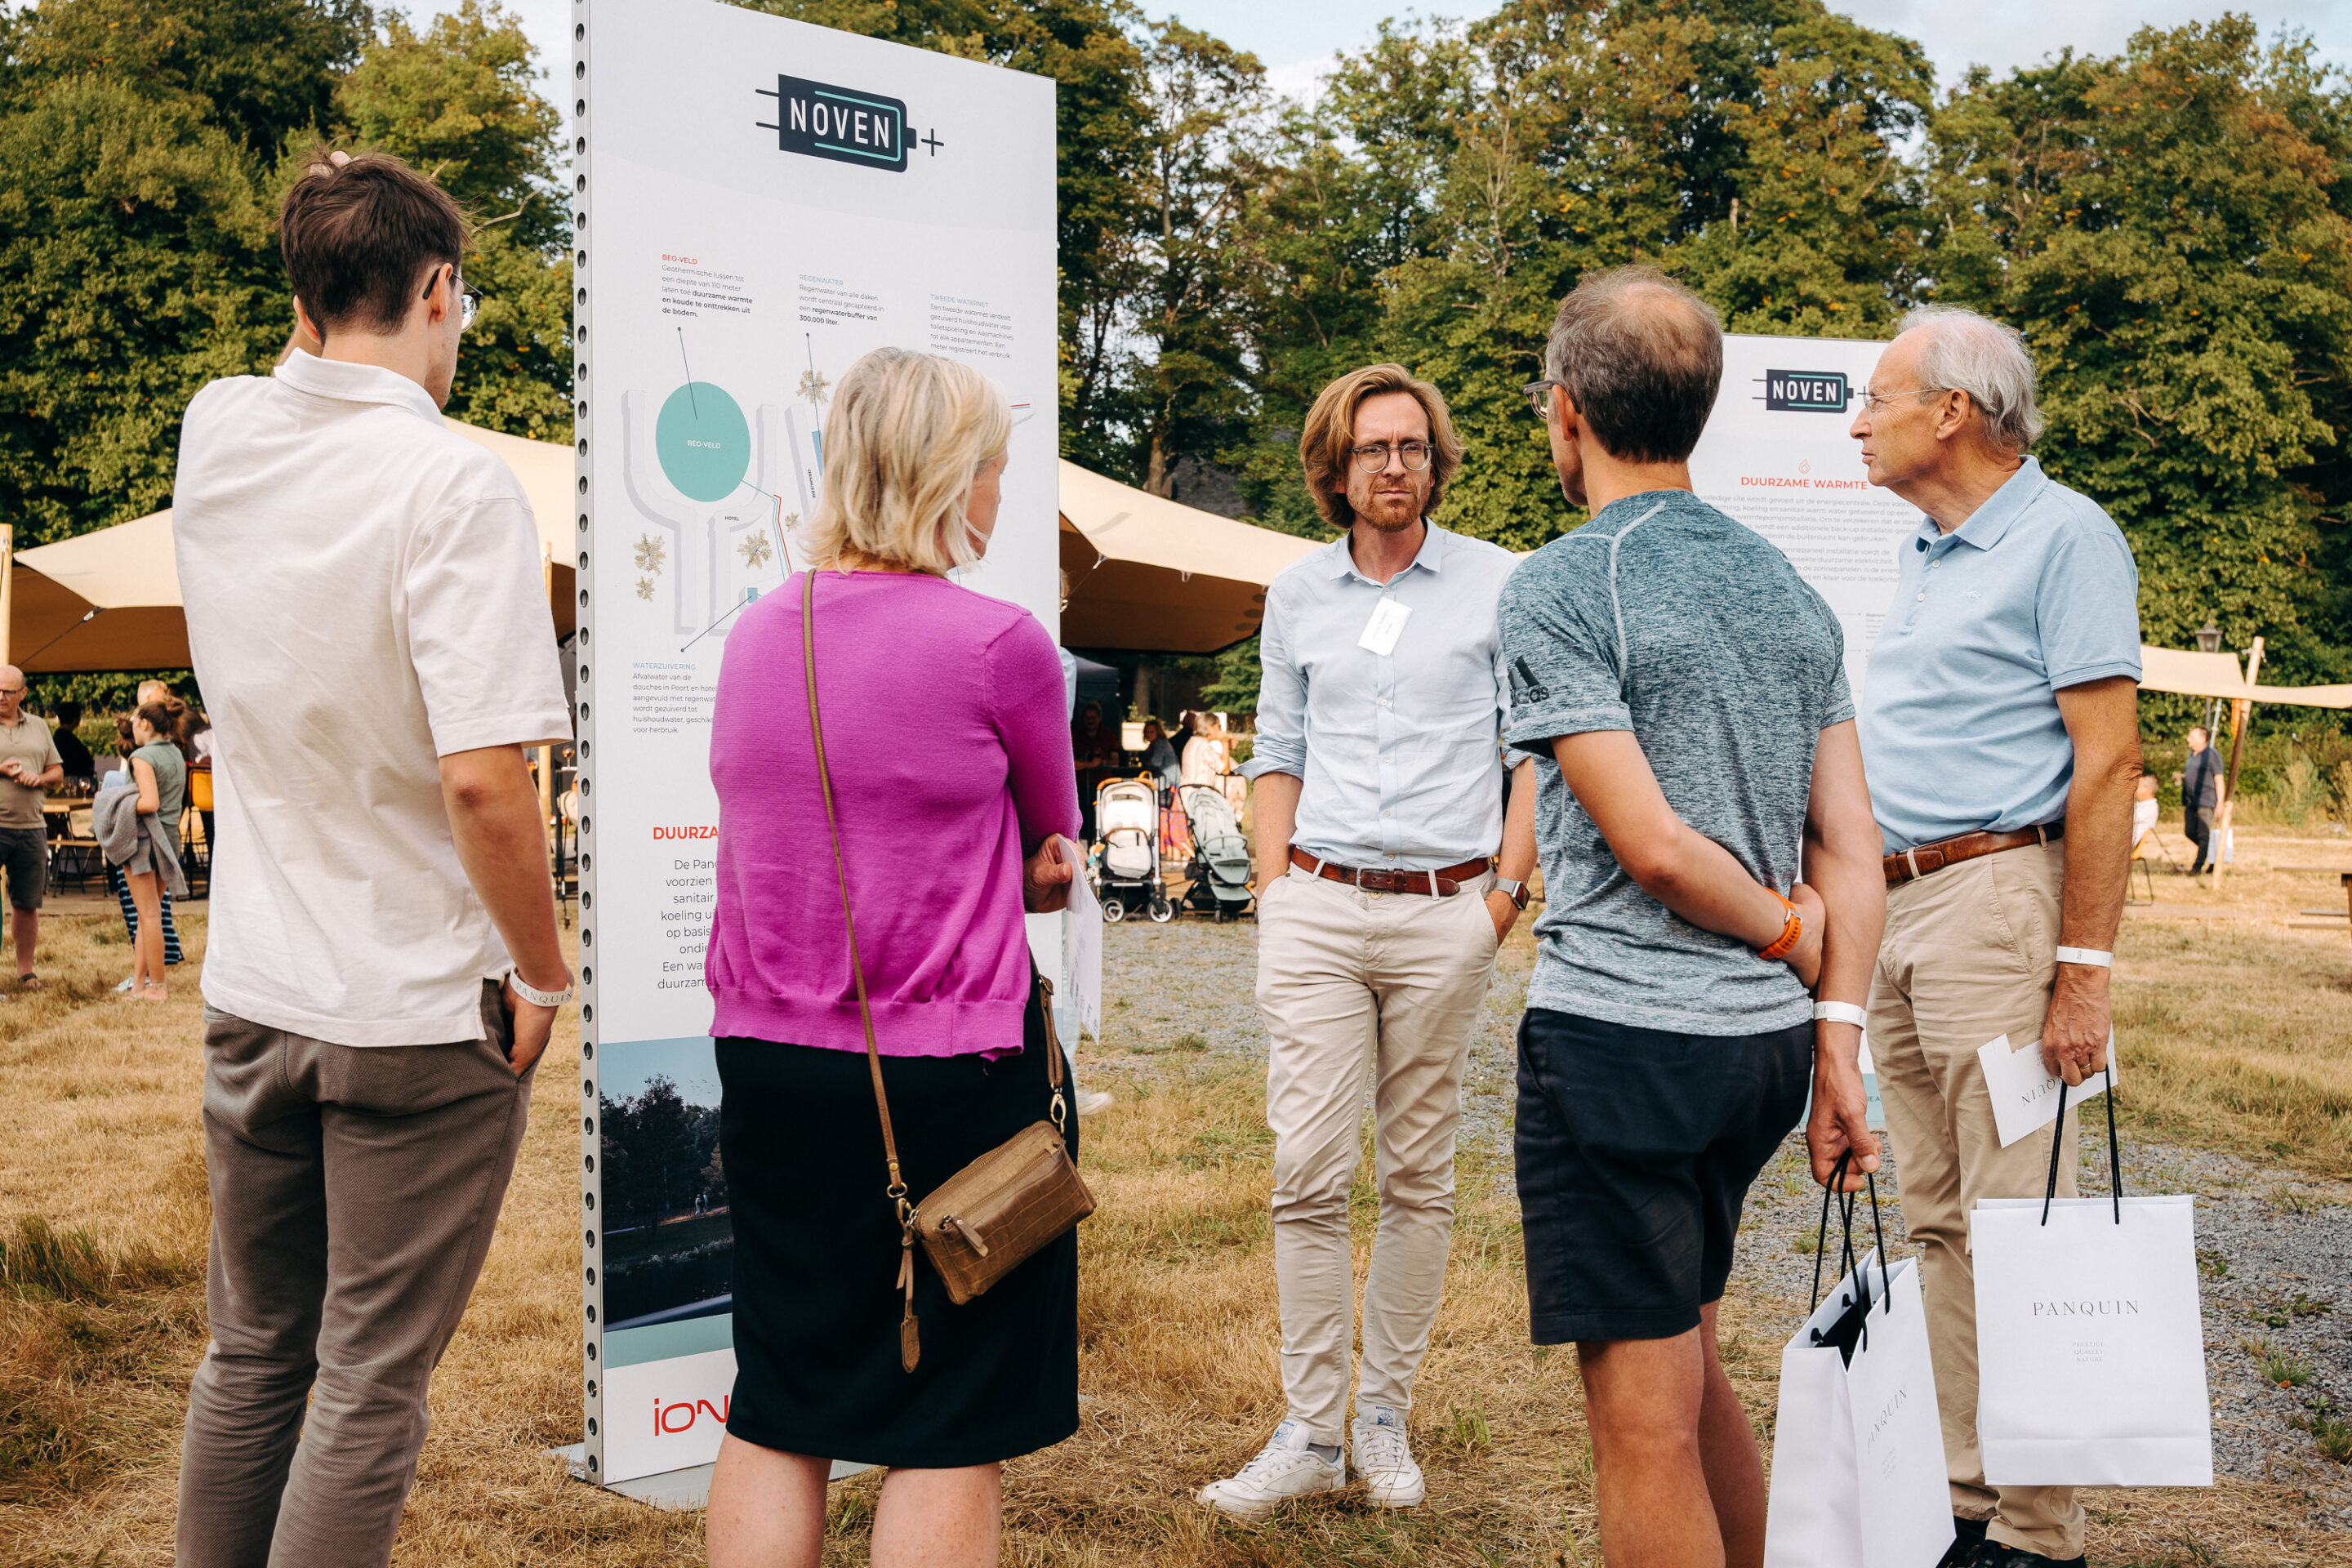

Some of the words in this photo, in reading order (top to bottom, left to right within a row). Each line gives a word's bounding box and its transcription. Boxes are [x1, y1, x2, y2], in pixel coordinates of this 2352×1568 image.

[791, 97, 889, 149] NOVEN
[662, 254, 697, 265] BEO-VELD
[662, 265, 712, 278] Geothermische
[714, 272, 733, 280] lussen
[676, 278, 697, 286] diepte
[800, 274, 843, 286] REGENWATER
[662, 286, 678, 294] laten
[693, 290, 726, 301] duurzame
[728, 295, 752, 304] warmte
[800, 284, 835, 294] Regenwater
[673, 298, 693, 306] koude
[704, 302, 740, 312] onttrekken
[818, 297, 842, 305] centraal
[844, 301, 877, 310] gecapteerd
[931, 294, 955, 302] TWEEDE
[957, 298, 988, 307] WATERNET
[673, 308, 698, 317] bodem.
[813, 307, 865, 319] regenwaterbuffer
[800, 315, 824, 323] 300.000
[930, 314, 957, 323] gezuiverd
[959, 317, 999, 328] huishoudwater
[931, 324, 968, 335] toiletspoeling
[978, 331, 1013, 340] wasmachines
[1773, 380, 1837, 402] NOVEN
[687, 440, 721, 448] BEO-VELD
[1740, 476, 1810, 488] DUURZAME
[1814, 479, 1868, 490] WARMTE
[675, 860, 689, 870] De
[666, 876, 712, 887] voorzien
[674, 893, 714, 903] sanitair
[662, 911, 702, 921] koeling
[666, 929, 680, 939] op
[684, 926, 710, 937] basis
[662, 961, 684, 972] Een
[2034, 1300, 2138, 1316] PANQUIN
